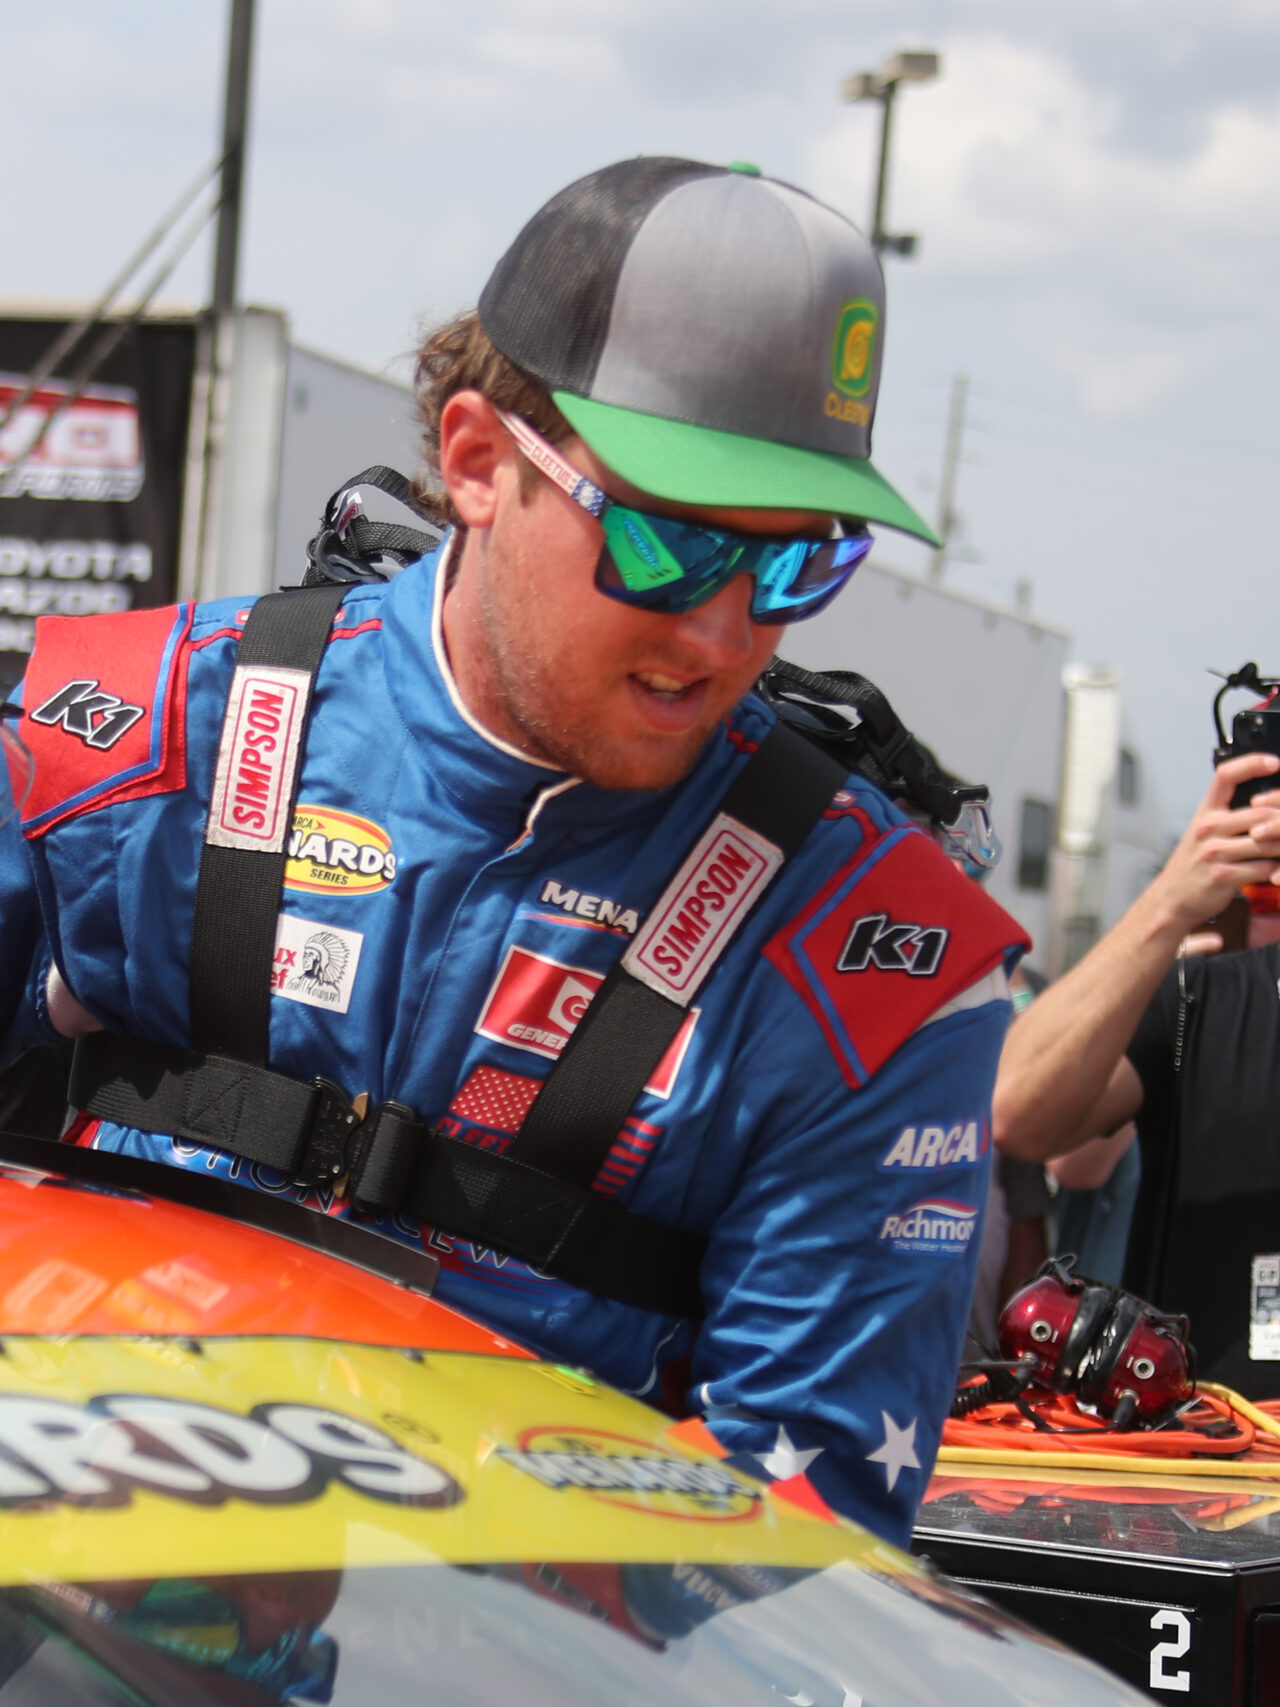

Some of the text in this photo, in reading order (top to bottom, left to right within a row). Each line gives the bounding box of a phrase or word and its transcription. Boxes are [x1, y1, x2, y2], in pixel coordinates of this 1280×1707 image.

[30, 679, 146, 750] K1
[232, 688, 285, 830] SIMPSON
[310, 868, 349, 886] SERIES
[652, 843, 753, 977] SIMPSON
[836, 912, 950, 977] K1
[881, 1122, 978, 1168] ARCA
[1149, 1608, 1191, 1693] 2
